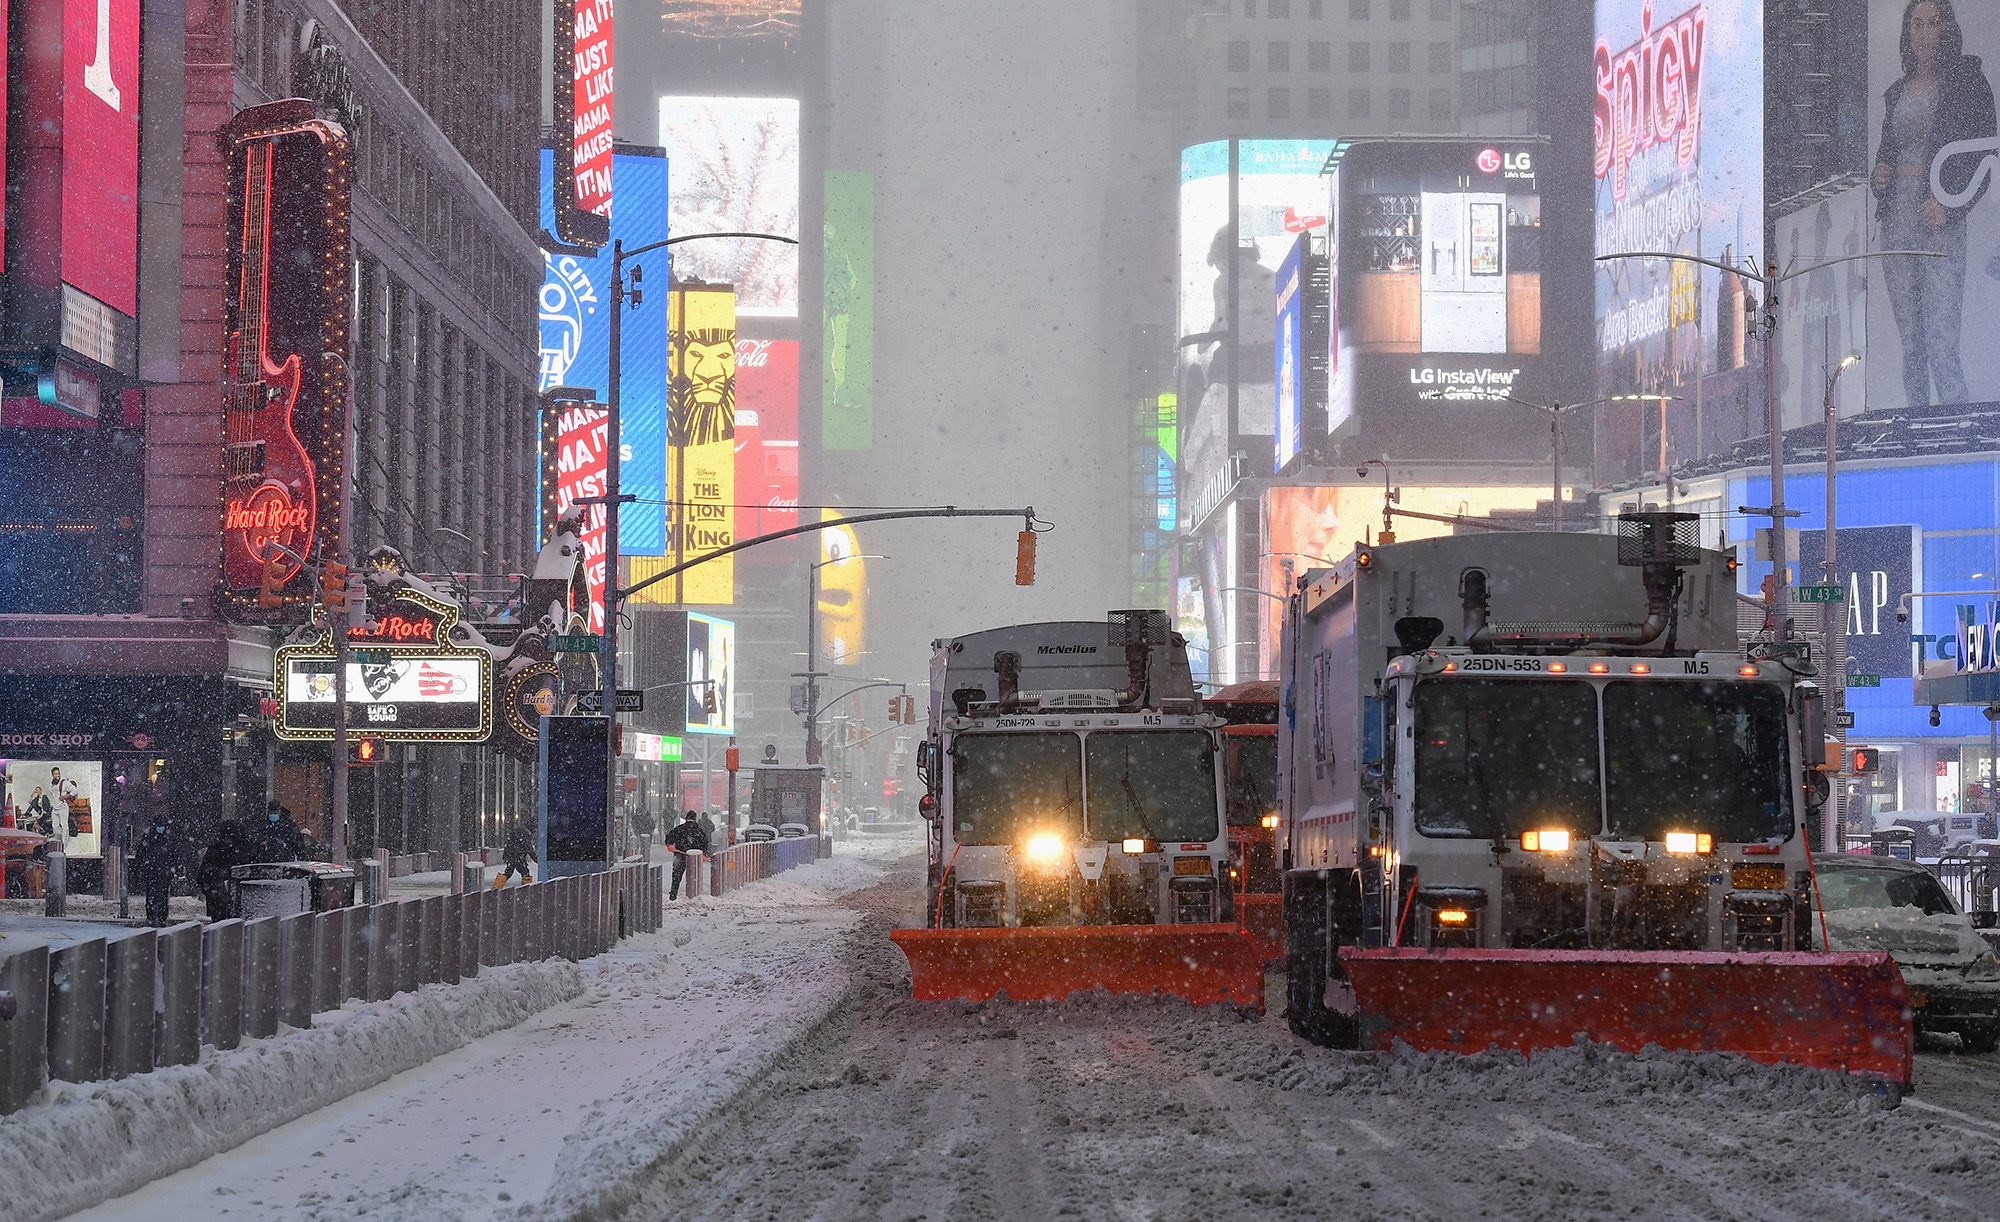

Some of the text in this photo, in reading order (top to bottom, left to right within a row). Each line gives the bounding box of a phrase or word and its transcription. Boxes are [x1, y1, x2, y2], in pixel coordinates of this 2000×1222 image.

[575, 39, 608, 80] JUST
[1595, 0, 1707, 201] Spicy
[574, 103, 611, 139] MAMA
[574, 128, 613, 168] MAKES
[1504, 152, 1531, 170] LG
[1628, 285, 1670, 342] Back!
[1410, 368, 1435, 384] LG
[695, 467, 717, 477] Disney
[693, 483, 720, 497] THE
[226, 499, 309, 533] Hard Rock
[1801, 588, 1812, 601] W
[1816, 587, 1831, 601] 43
[1846, 570, 1888, 636] AP
[388, 615, 434, 640] Rock
[573, 639, 587, 651] 43
[1037, 644, 1097, 655] McNeilus
[1463, 658, 1709, 675] 25DN-553 M.5
[1847, 675, 1856, 686] W
[1859, 675, 1870, 686] 43
[523, 693, 545, 704] Hard
[617, 696, 638, 706] WAY
[367, 707, 388, 715] SAFE
[368, 714, 398, 722] SOUND
[995, 715, 1162, 728] 25DN-729 M.5
[1, 734, 94, 746] ROCK SHOP
